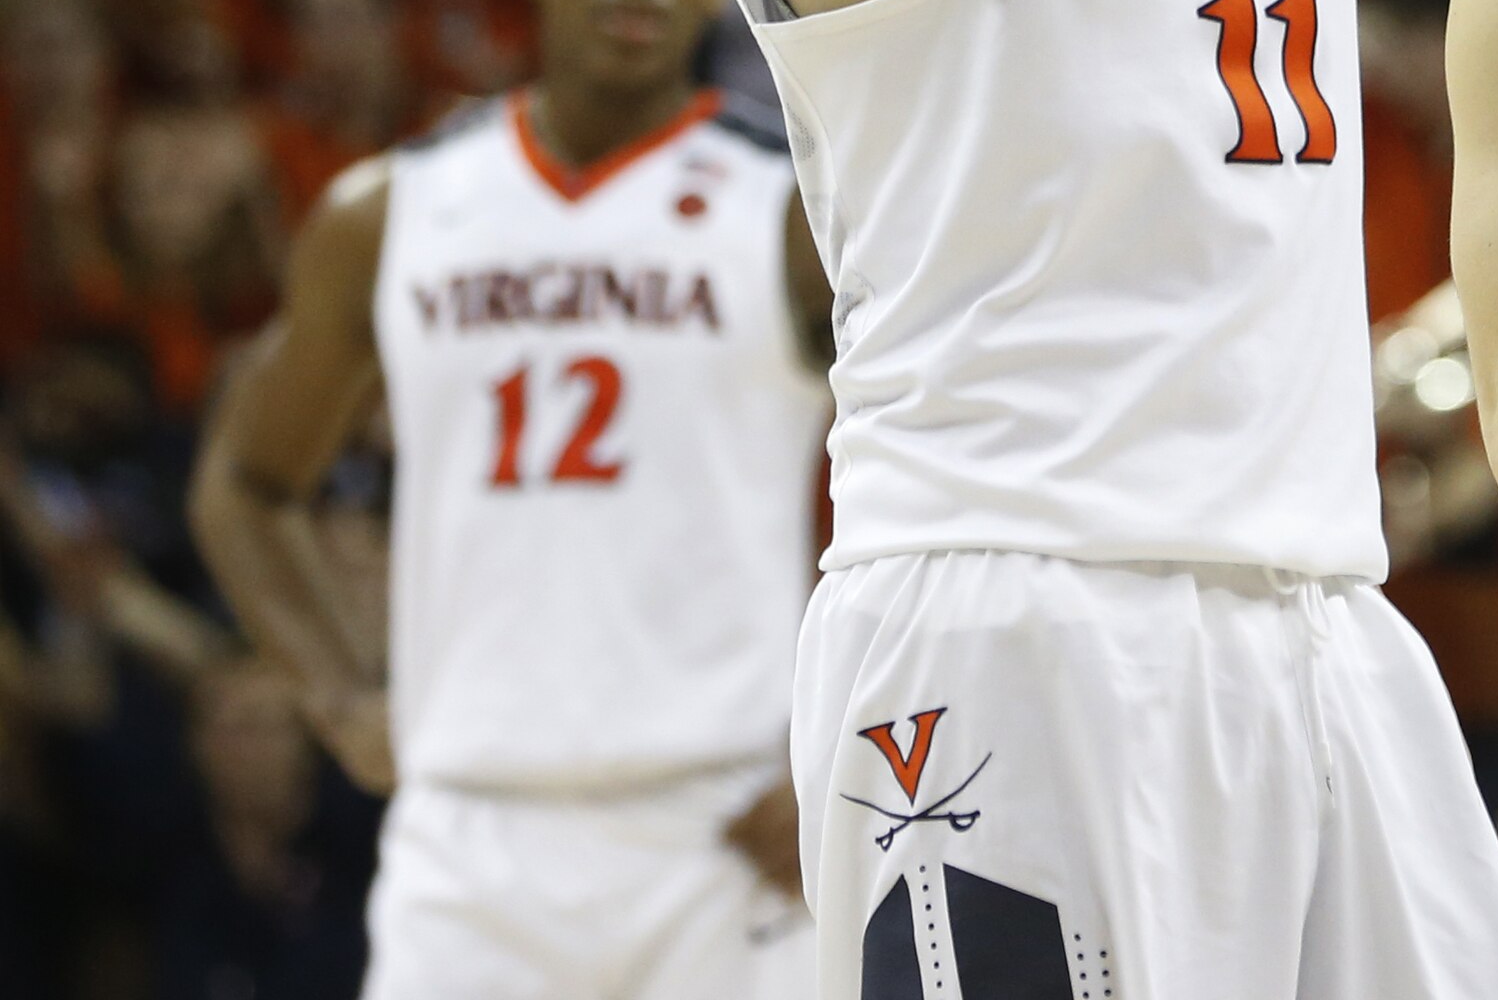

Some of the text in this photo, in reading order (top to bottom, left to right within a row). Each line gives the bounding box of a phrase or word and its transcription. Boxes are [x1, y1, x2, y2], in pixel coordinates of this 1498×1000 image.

[413, 262, 722, 333] VIRGINIA
[488, 352, 626, 488] 12
[857, 706, 948, 808] V
